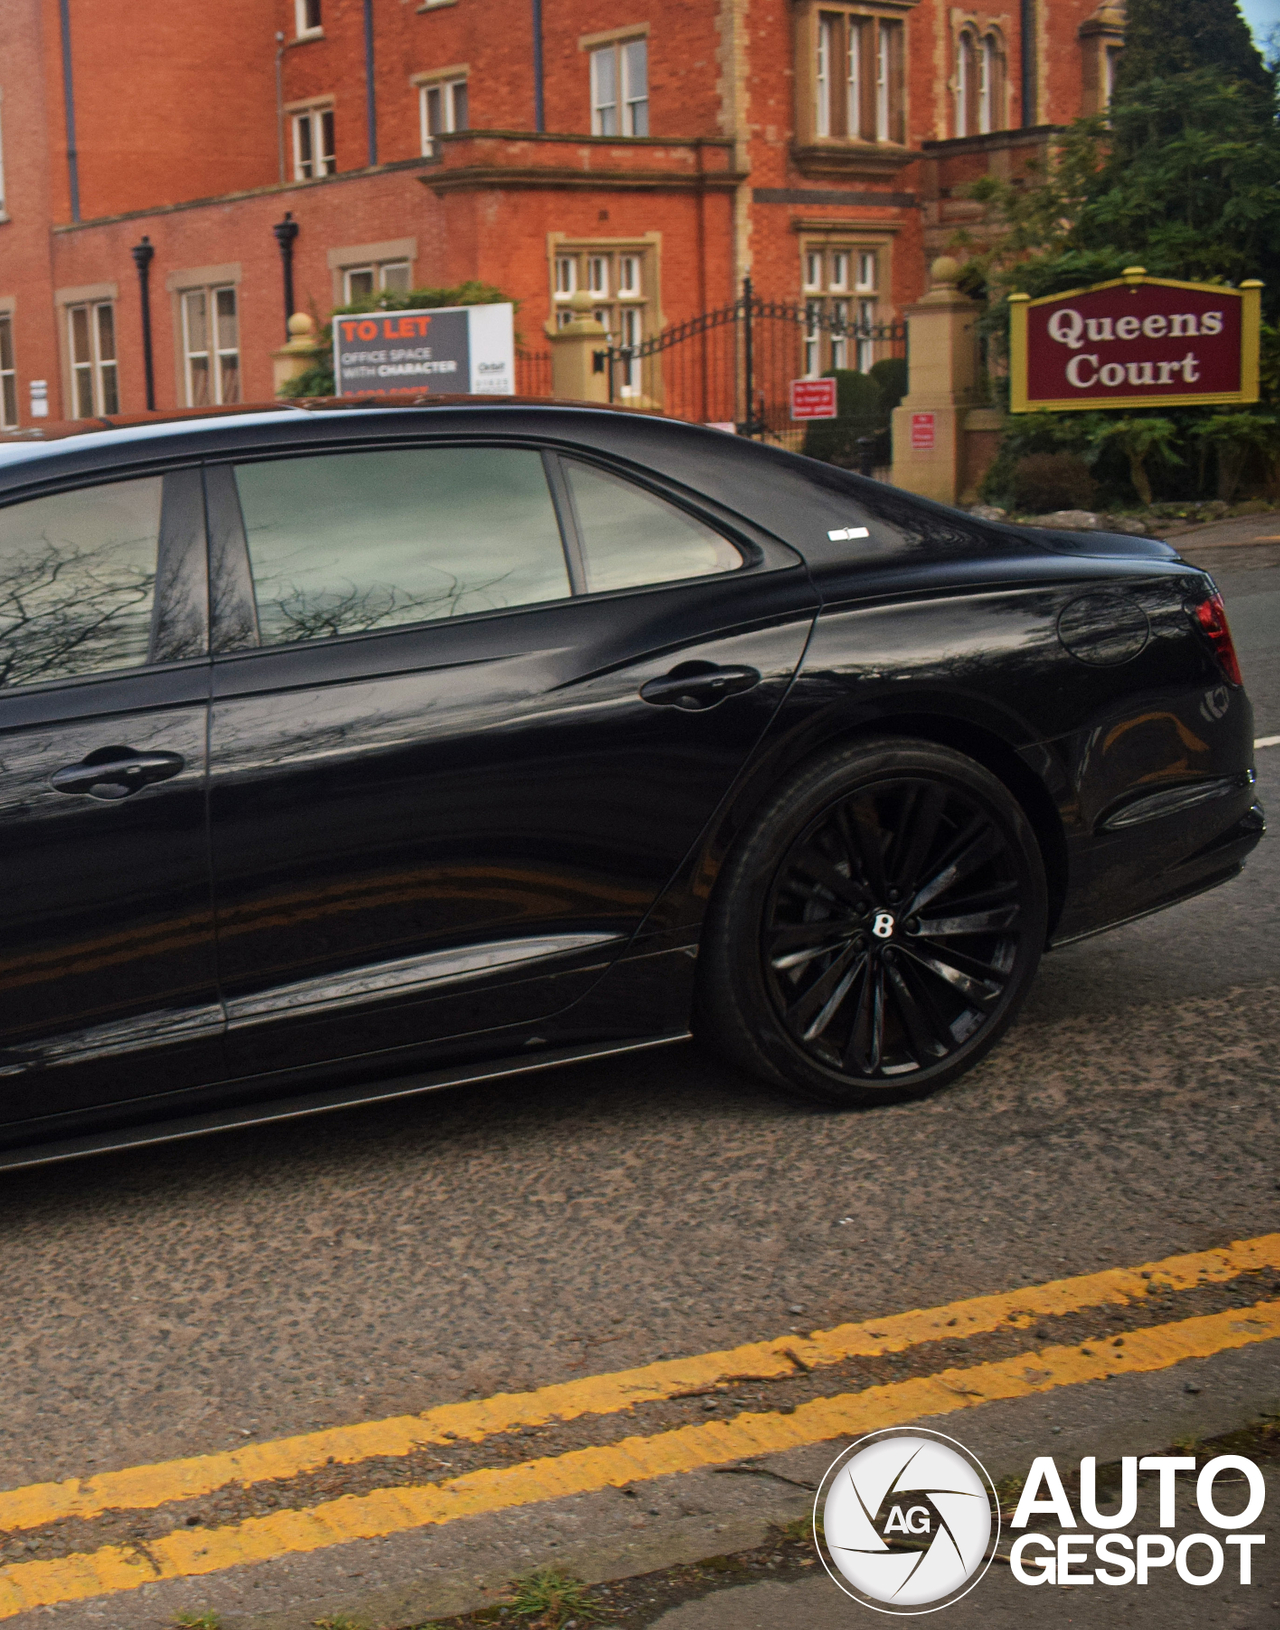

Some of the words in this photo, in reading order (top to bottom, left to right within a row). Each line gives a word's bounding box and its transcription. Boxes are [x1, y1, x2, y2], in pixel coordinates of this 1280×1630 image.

[340, 319, 379, 342] TO
[383, 315, 432, 340] LET
[1047, 308, 1224, 349] Queens
[341, 350, 388, 366] OFFICE
[389, 347, 432, 361] SPACE
[342, 366, 376, 379] WITH
[377, 360, 458, 377] CHARACTER
[1065, 352, 1200, 388] Court
[872, 913, 895, 938] B
